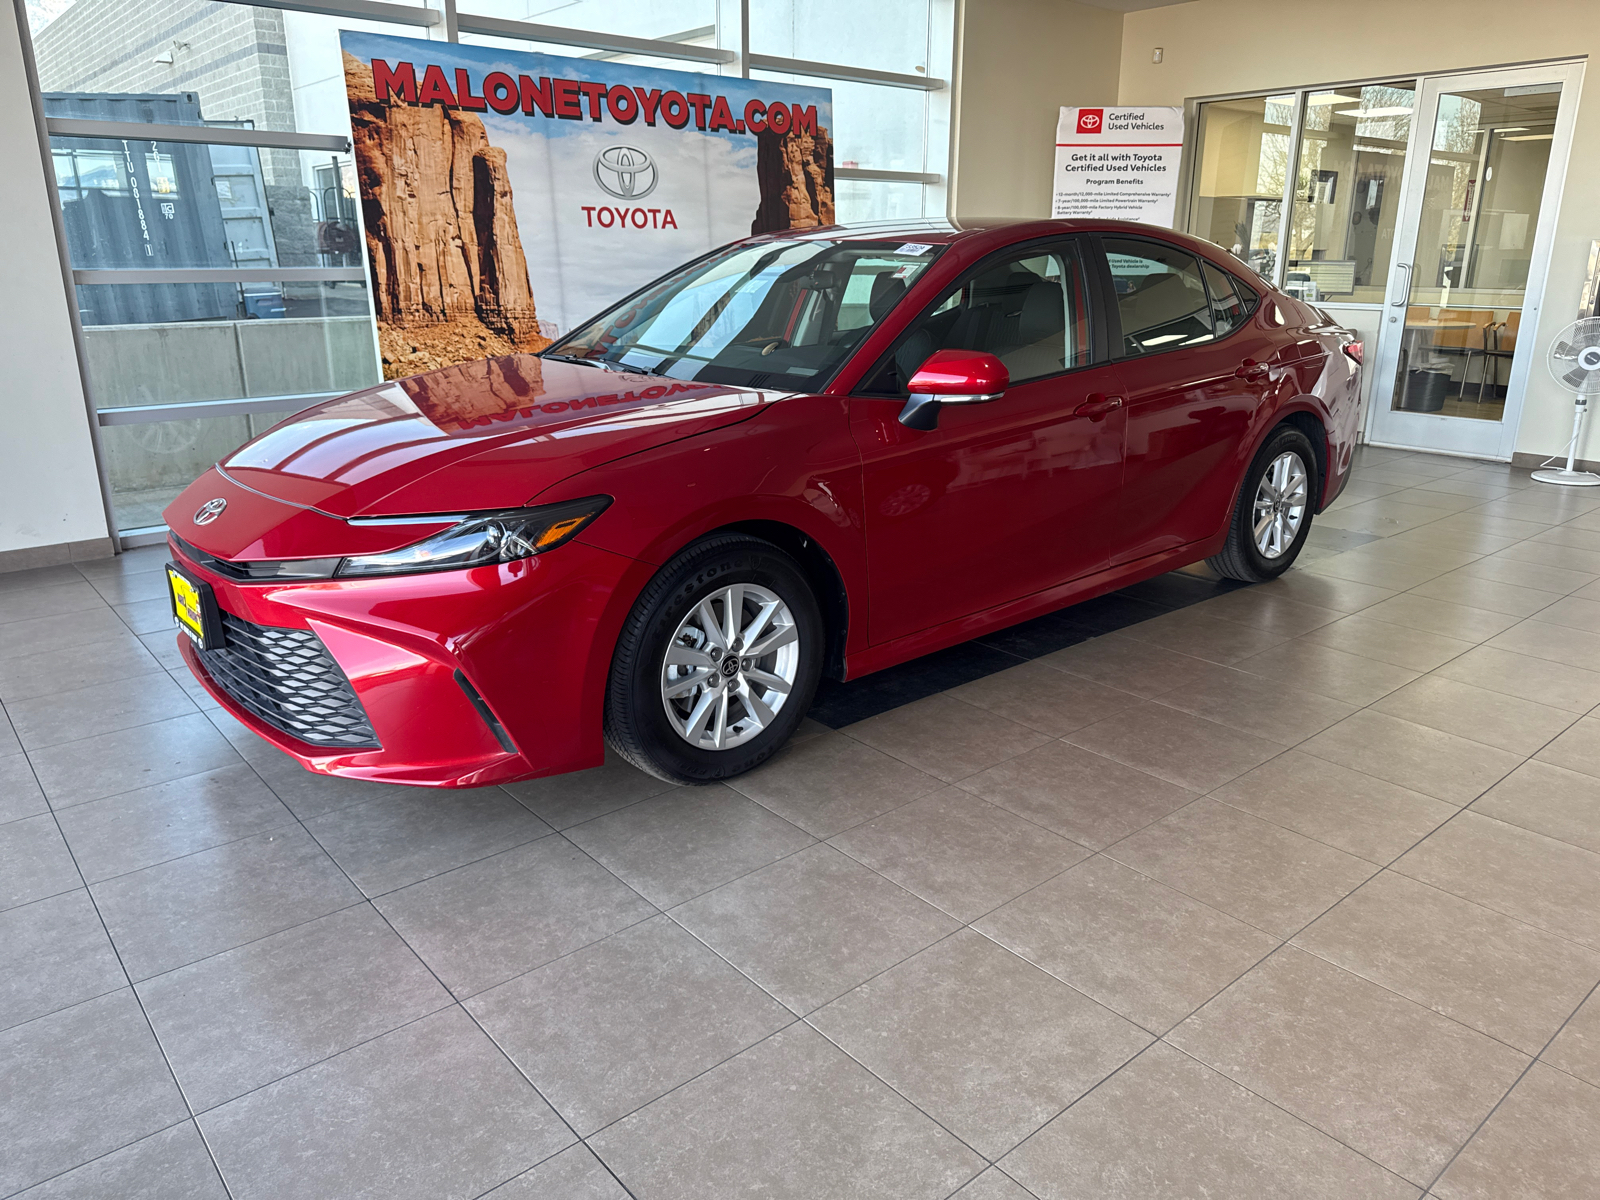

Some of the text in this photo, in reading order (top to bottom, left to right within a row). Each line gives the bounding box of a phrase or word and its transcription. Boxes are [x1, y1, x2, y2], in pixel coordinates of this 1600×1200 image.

[371, 58, 818, 137] MALONETOYOTA.COM
[1108, 113, 1144, 121] Certified
[1130, 122, 1164, 130] Vehicles
[1071, 153, 1162, 163] Get it all with Toyota
[1065, 164, 1166, 172] Certified Used Vehicles
[581, 205, 678, 229] TOYOTA
